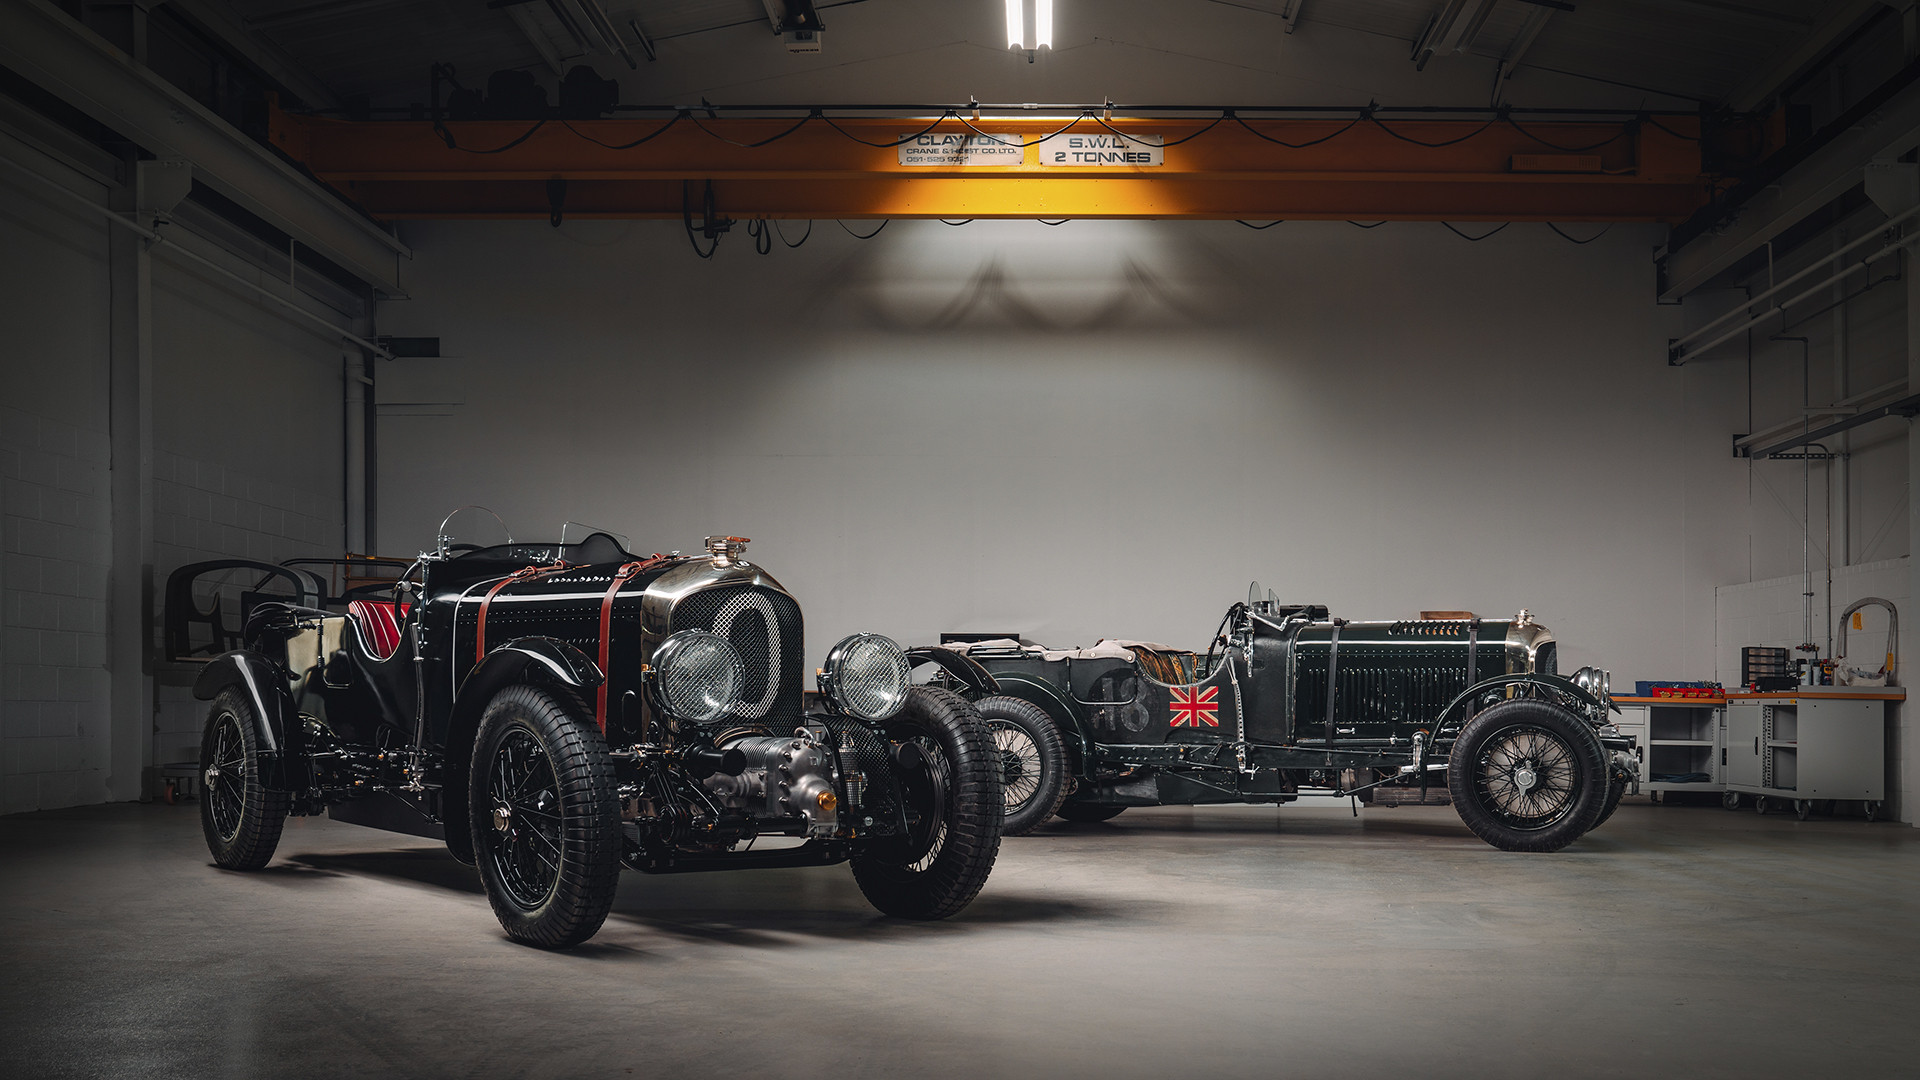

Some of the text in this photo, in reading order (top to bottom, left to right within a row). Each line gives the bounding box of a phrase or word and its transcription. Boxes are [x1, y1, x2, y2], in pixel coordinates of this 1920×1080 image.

[917, 135, 1006, 146] CLAYTON
[1069, 137, 1130, 149] S.W.L.
[1055, 151, 1151, 163] 2 TONNES
